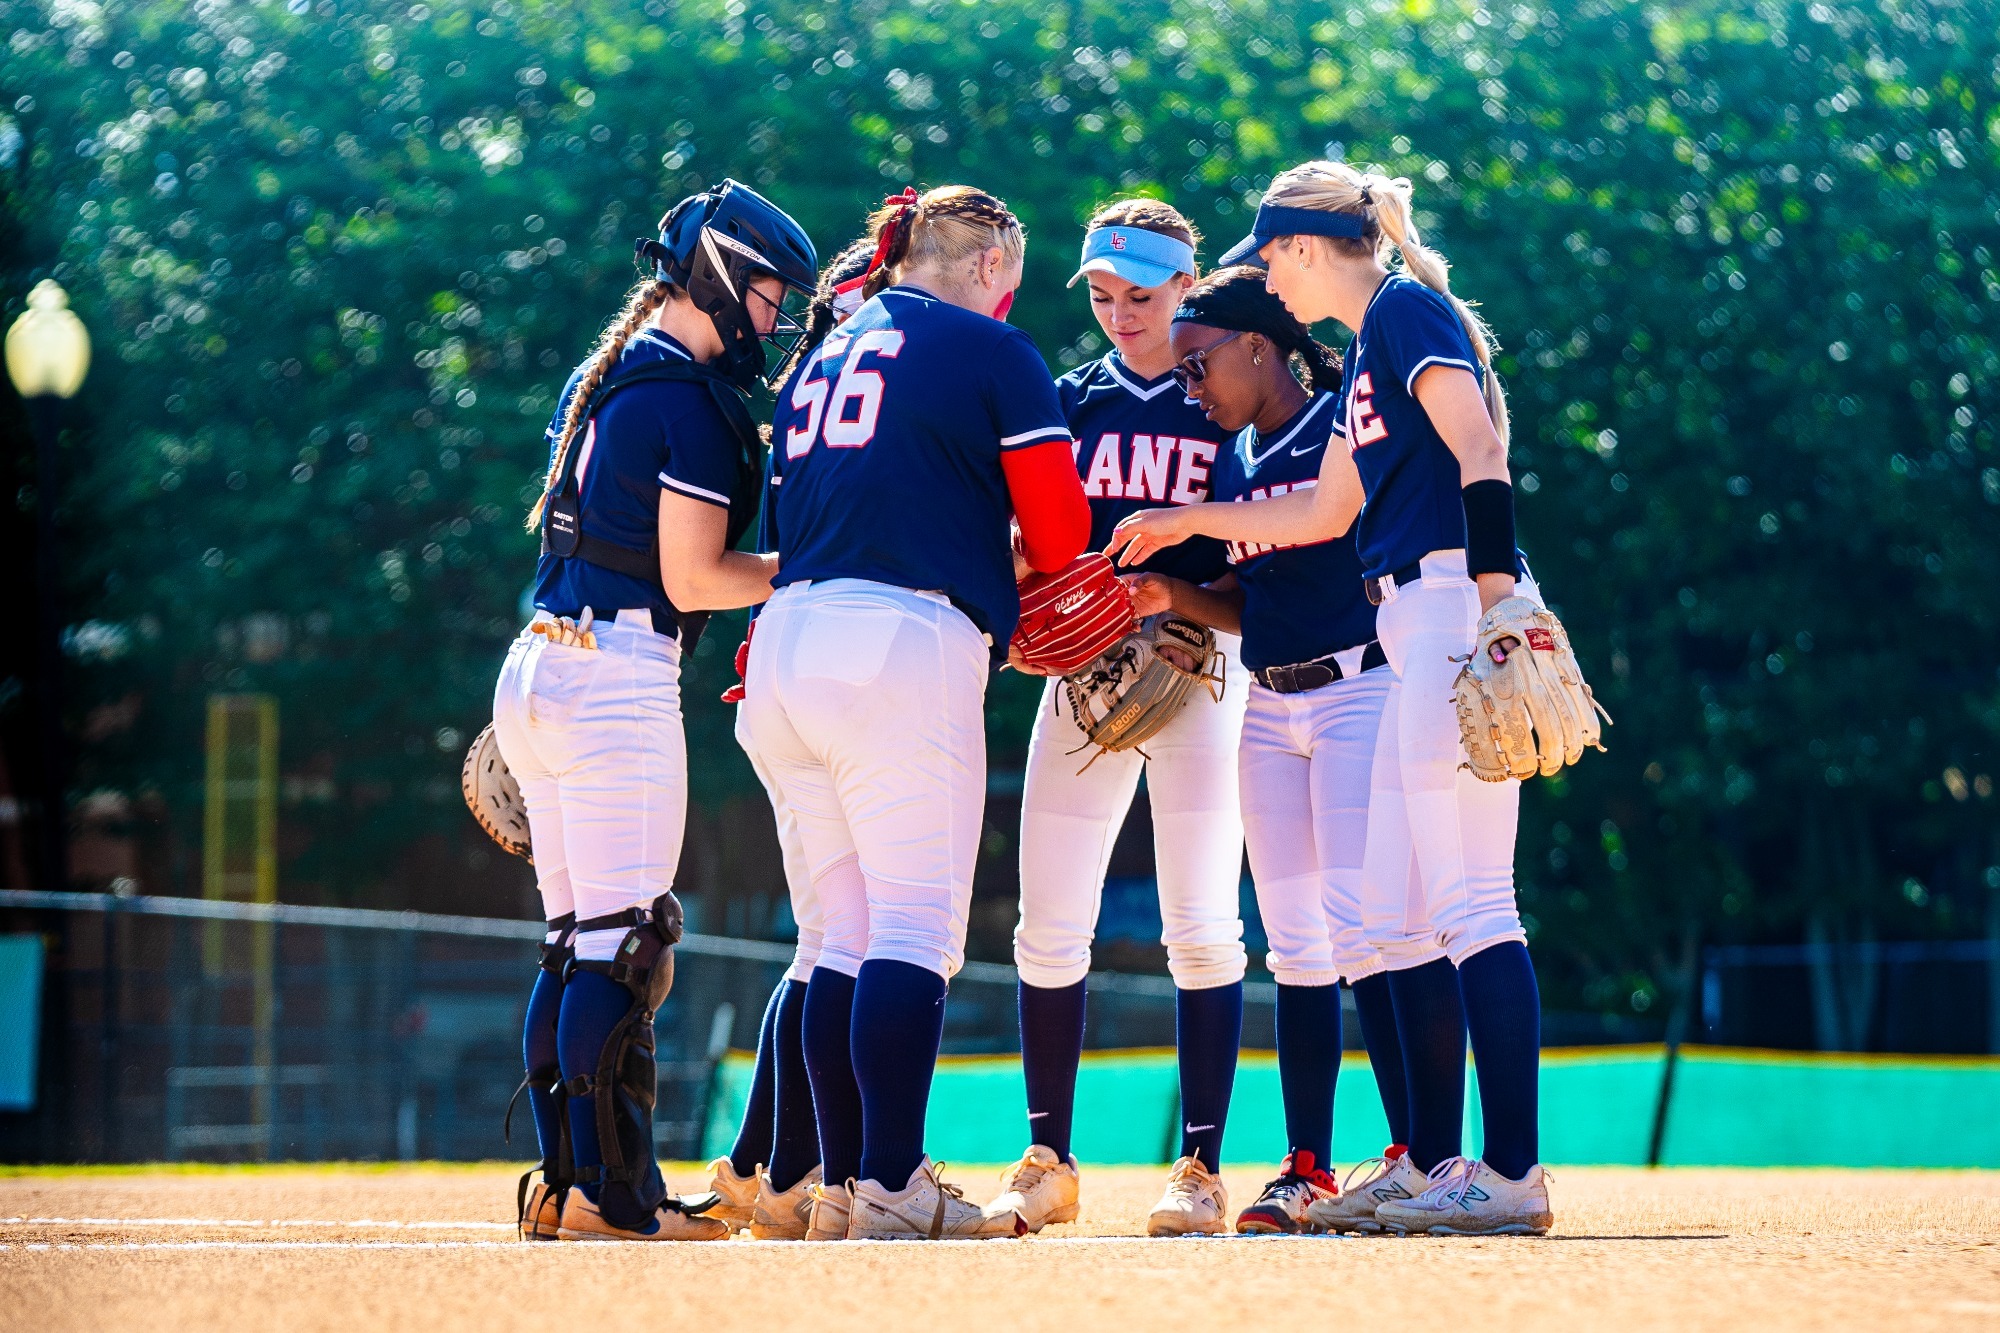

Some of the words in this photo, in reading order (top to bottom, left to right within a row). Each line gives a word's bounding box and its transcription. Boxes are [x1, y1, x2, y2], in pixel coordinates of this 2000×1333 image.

[731, 243, 761, 260] EASTON
[1111, 232, 1126, 250] LC
[786, 329, 906, 462] 56
[1167, 621, 1203, 645] Wilson
[1110, 702, 1141, 734] A2000
